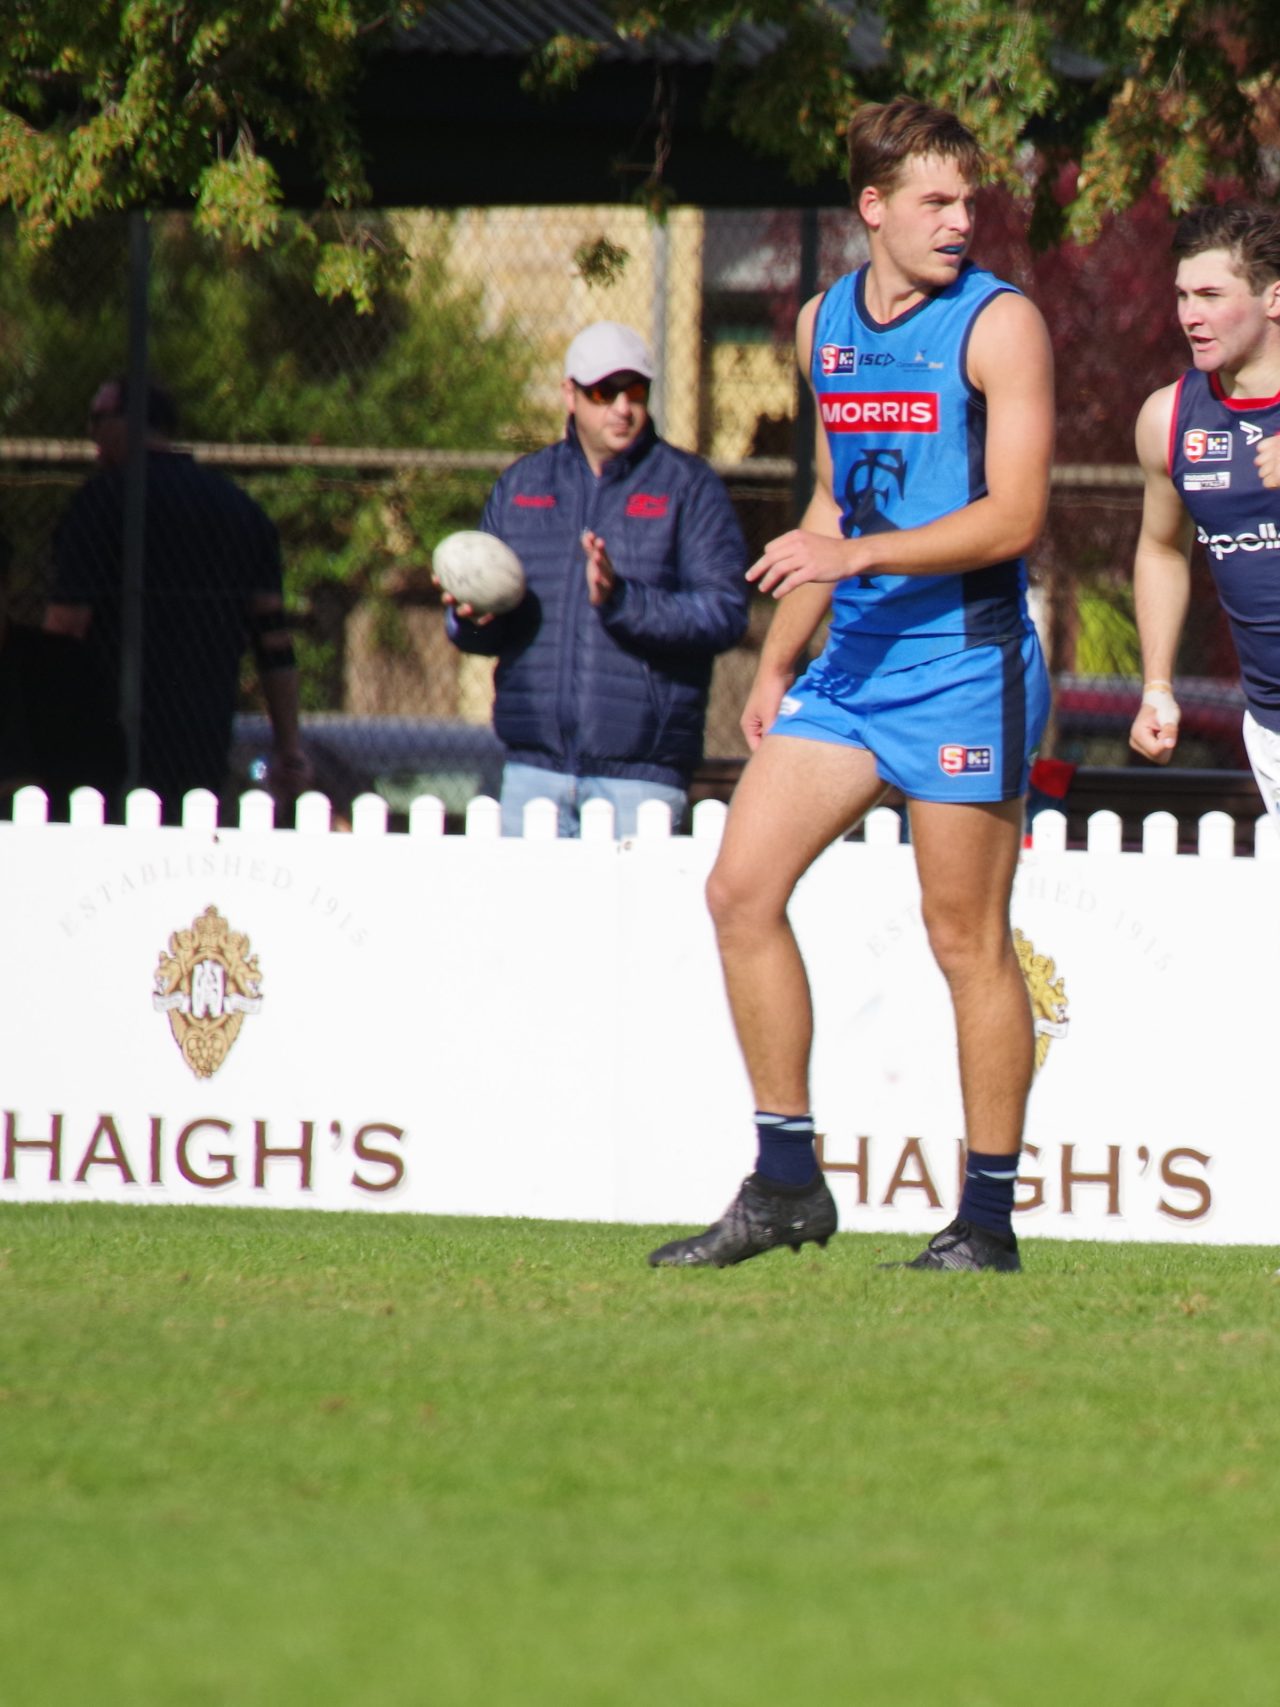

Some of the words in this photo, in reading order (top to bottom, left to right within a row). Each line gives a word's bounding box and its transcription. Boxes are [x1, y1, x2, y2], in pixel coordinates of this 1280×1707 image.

[821, 401, 932, 423] MORRIS
[57, 852, 295, 939] ESTABLISHED
[308, 885, 370, 948] 1915
[1111, 907, 1176, 973] 1915
[3, 1111, 406, 1193] HAIGH'S
